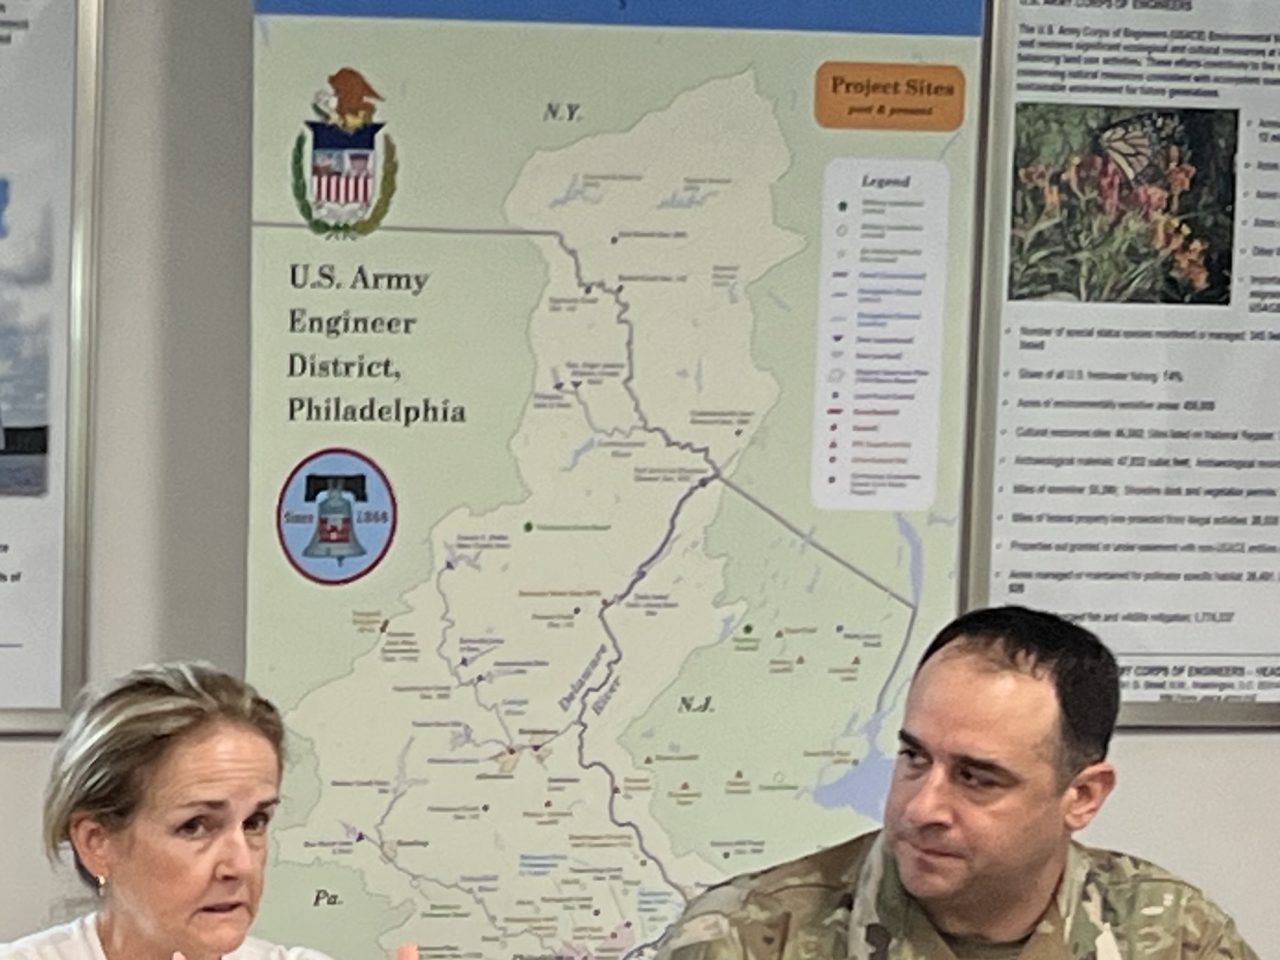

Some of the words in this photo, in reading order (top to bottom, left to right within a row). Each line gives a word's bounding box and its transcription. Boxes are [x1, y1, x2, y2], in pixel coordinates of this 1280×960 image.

[832, 76, 900, 97] Project
[906, 79, 954, 96] Sites
[543, 103, 583, 122] N.Y.
[861, 174, 911, 188] Legend
[289, 264, 342, 290] U.S.
[350, 265, 430, 295] Army
[289, 309, 416, 338] Engineer
[287, 353, 401, 381] District,
[287, 398, 467, 427] Philadelphia
[678, 696, 715, 712] N.J.
[314, 890, 344, 906] Pa.
